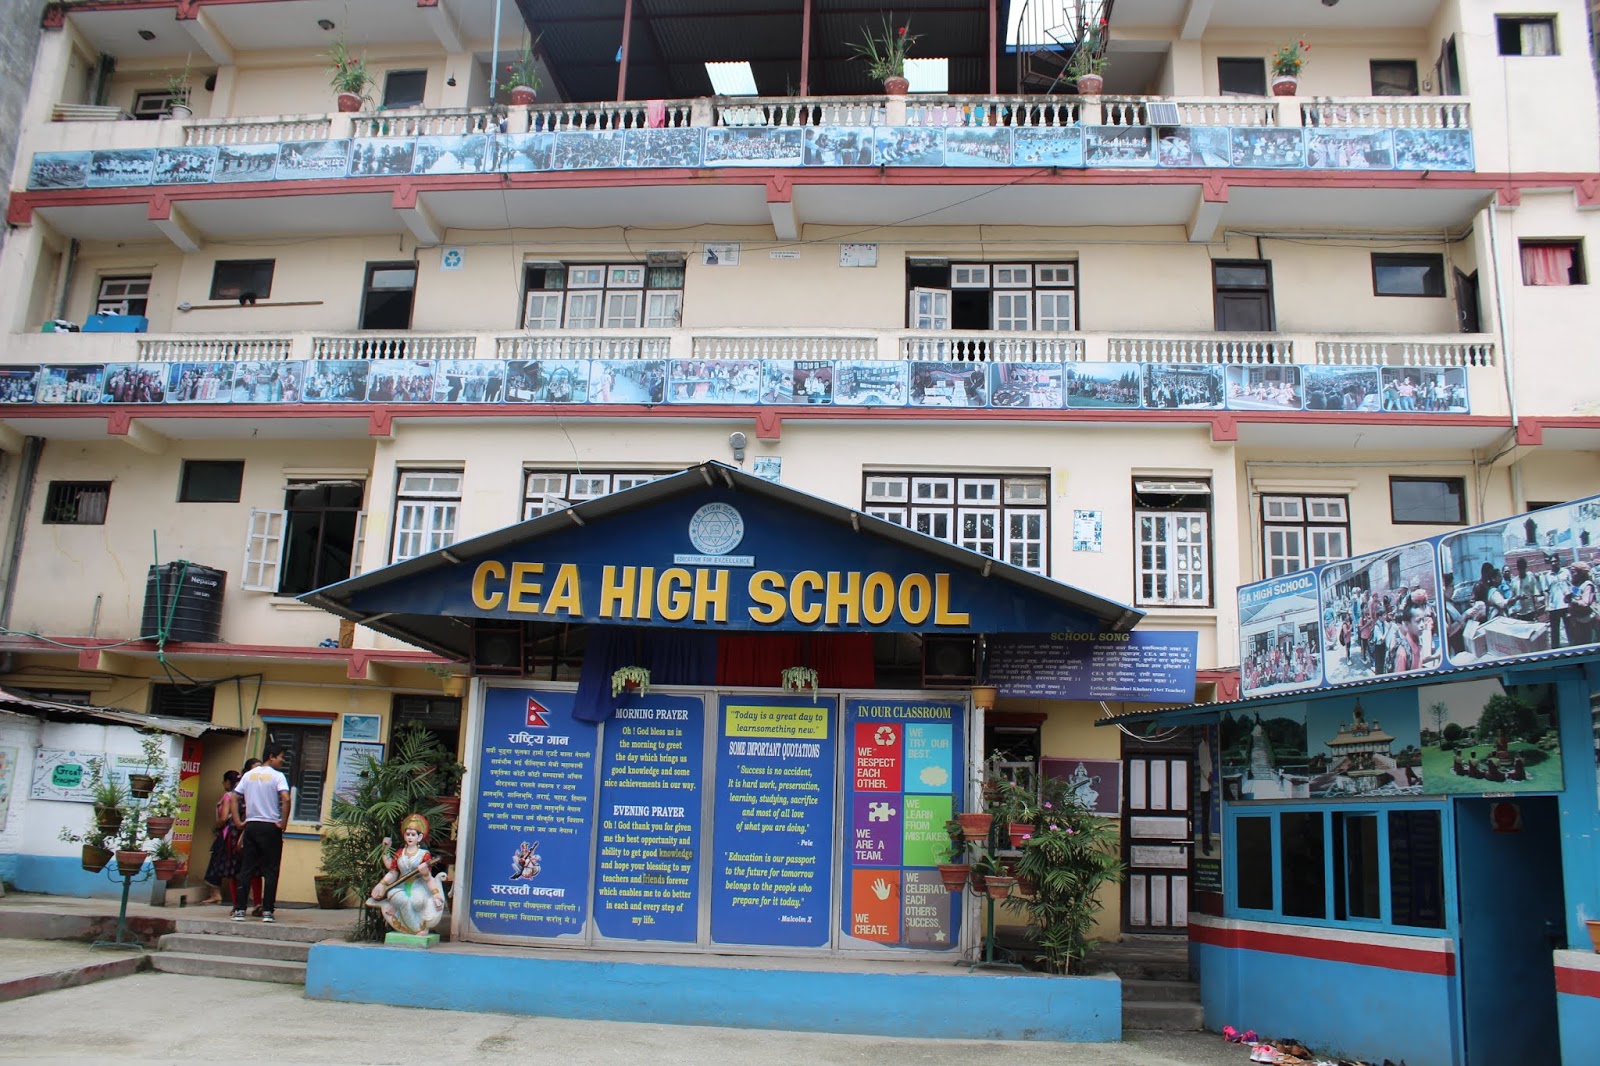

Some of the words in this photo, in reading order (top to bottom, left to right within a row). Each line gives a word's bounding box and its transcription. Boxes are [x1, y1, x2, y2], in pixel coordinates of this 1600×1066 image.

[702, 505, 720, 514] HIGH
[471, 560, 582, 616] CEA
[599, 565, 730, 622] HIGH
[748, 570, 970, 626] SCHOOL
[1239, 594, 1252, 603] EA
[1253, 587, 1272, 600] HIGH
[1274, 577, 1312, 595] SCHOOL
[1098, 633, 1130, 642] SONG
[615, 708, 654, 719] MORNING
[656, 709, 688, 720] PRAYER
[858, 706, 869, 717] IN
[871, 706, 891, 717] OUR
[893, 707, 951, 718] CLASSROOM
[776, 713, 796, 721] great
[799, 713, 814, 722] day
[637, 727, 649, 735] God
[650, 727, 665, 735] bless
[676, 728, 682, 736] in
[737, 724, 796, 735] learnsomething
[909, 728, 923, 736] WE
[547, 736, 569, 745] गान
[620, 740, 630, 748] the
[632, 740, 657, 750] morning
[666, 742, 682, 751] greet
[909, 739, 926, 748] TRY
[931, 739, 948, 748] OUR
[729, 742, 746, 755] SOME
[747, 742, 781, 756] IMPORTANT
[782, 743, 820, 760] QUOTATIONS
[858, 747, 872, 756] WE
[908, 750, 931, 759] BEST.
[627, 753, 638, 763] day
[640, 753, 658, 761] which
[660, 754, 678, 764] brings
[858, 758, 895, 767] RESPECT
[56, 765, 83, 776] Great
[612, 766, 626, 775] good
[628, 766, 659, 777] knowledge
[661, 767, 672, 775] and
[767, 766, 772, 774] is
[784, 767, 812, 777] accident,
[857, 769, 880, 777] EACH
[605, 778, 617, 786] nice
[619, 779, 660, 788] achievements
[662, 780, 668, 788] in
[682, 782, 696, 791] way.
[728, 779, 733, 787] It
[735, 779, 741, 787] is
[742, 779, 758, 788] hard
[760, 780, 777, 790] work,
[778, 782, 820, 791] preservation,
[857, 779, 888, 788] OTHER.
[730, 793, 757, 804] learning,
[760, 794, 789, 805] studying,
[790, 795, 818, 806] sacrifice
[906, 800, 919, 808] WE
[614, 805, 649, 816] EVENING
[652, 807, 684, 817] PRAYER
[742, 808, 754, 816] and
[756, 808, 771, 816] most
[773, 808, 780, 819] of
[781, 808, 790, 817] all
[792, 809, 804, 818] love
[906, 810, 933, 819] LEARN
[618, 821, 630, 829] God
[632, 822, 650, 830] thank
[652, 824, 663, 832] you
[665, 822, 673, 830] for
[675, 823, 691, 833] given
[905, 821, 930, 830] FROM
[856, 829, 870, 838] WE
[615, 834, 625, 842] the
[627, 834, 639, 843] best
[641, 836, 677, 846] opportunity
[679, 836, 690, 844] and
[856, 840, 874, 849] ARE
[878, 840, 884, 849] A
[765, 853, 771, 862] is
[786, 856, 816, 866] passport
[856, 851, 883, 860] TEAM.
[614, 861, 629, 871] hope
[631, 863, 645, 871] your
[647, 862, 671, 873] blessing
[673, 863, 679, 871] to
[681, 865, 691, 873] my
[725, 867, 732, 875] to
[734, 867, 745, 876] the
[746, 867, 768, 878] future
[768, 868, 779, 879] for
[781, 869, 814, 878] tomorrow
[906, 873, 919, 882] WE
[491, 884, 530, 895] सरस्वती
[532, 887, 565, 897] बन्दना
[725, 880, 751, 892] belongs
[753, 882, 759, 890] to
[762, 882, 772, 891] the
[774, 883, 796, 894] people
[798, 884, 812, 892] who
[599, 887, 617, 895] which
[619, 888, 642, 896] enables
[663, 889, 670, 897] do
[672, 890, 691, 898] better
[905, 896, 926, 904] EACH
[905, 907, 937, 916] OTHER'S
[855, 914, 869, 923] WE
[906, 918, 940, 928] SUCCESS.
[855, 925, 889, 935] CREATE.
